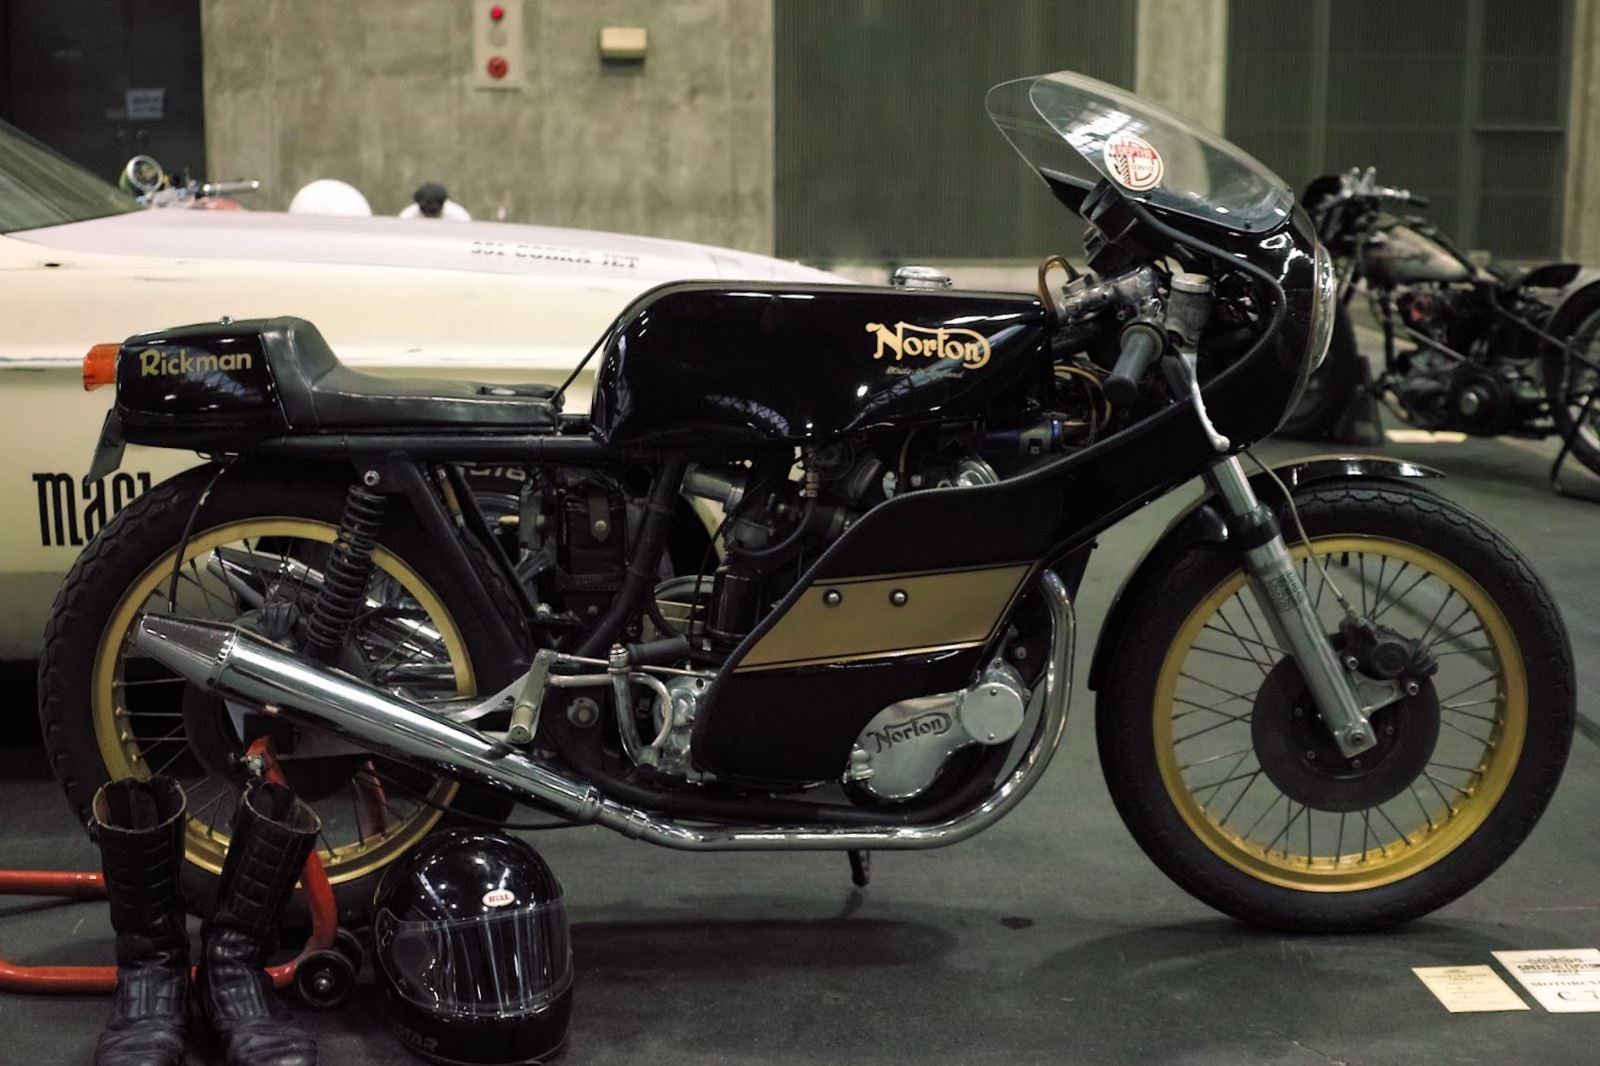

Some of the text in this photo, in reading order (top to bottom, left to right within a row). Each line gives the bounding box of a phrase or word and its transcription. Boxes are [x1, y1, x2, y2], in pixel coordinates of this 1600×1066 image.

[139, 349, 252, 376] Rickman
[865, 321, 991, 369] Norton
[32, 472, 152, 546] mac
[866, 712, 952, 753] Norton
[488, 893, 510, 903] BELL
